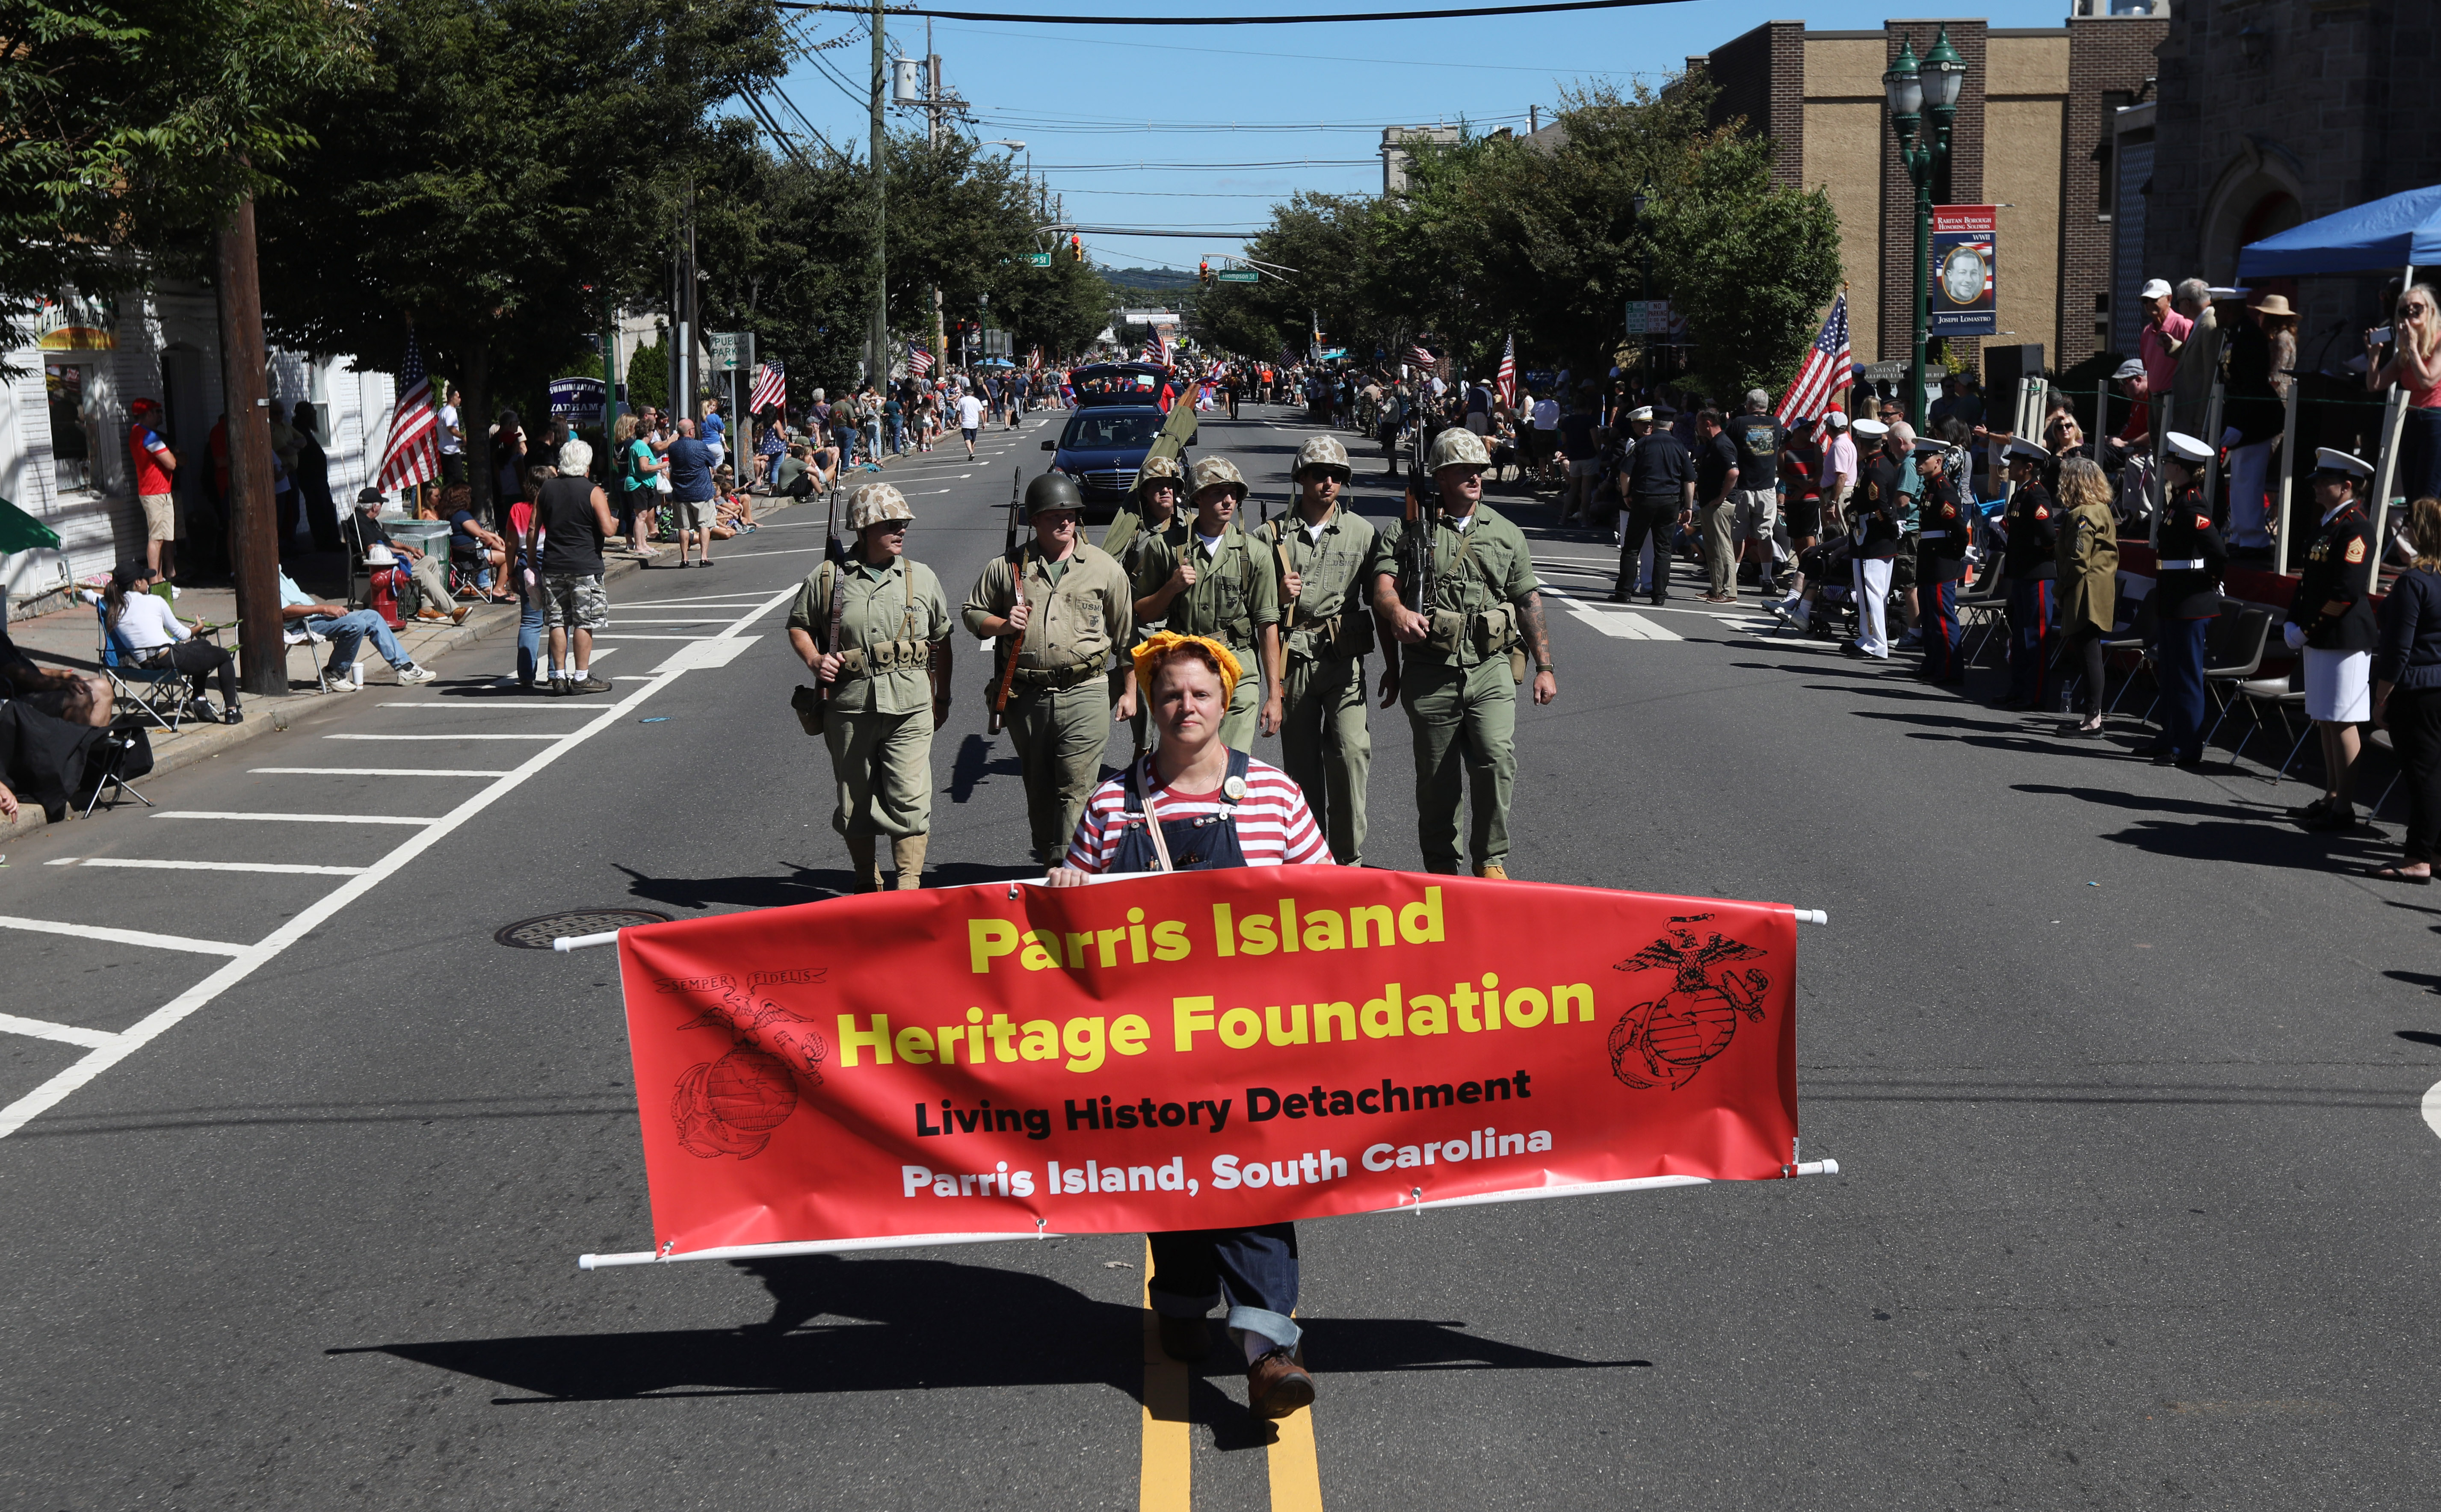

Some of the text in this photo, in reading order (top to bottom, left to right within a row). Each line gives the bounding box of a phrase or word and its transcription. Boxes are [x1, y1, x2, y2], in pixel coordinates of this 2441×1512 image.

[1627, 304, 1632, 312] 2
[41, 313, 50, 333] LA
[87, 310, 115, 333] LATINA
[1938, 316, 1959, 324] JOSEPH
[715, 335, 745, 346] PUBLIC
[712, 345, 748, 357] PARKING
[549, 383, 596, 395] SWAMINARAYAN
[1491, 550, 1514, 560] USMC
[900, 604, 922, 612] USMC
[968, 886, 1445, 973] Parris Island
[671, 970, 811, 992] SEMPER FIDELIS
[837, 983, 1595, 1073] Heritage Foundation
[916, 1070, 1531, 1140] Living History Detachment
[902, 1127, 1552, 1197] Parris Island, South Carolina
